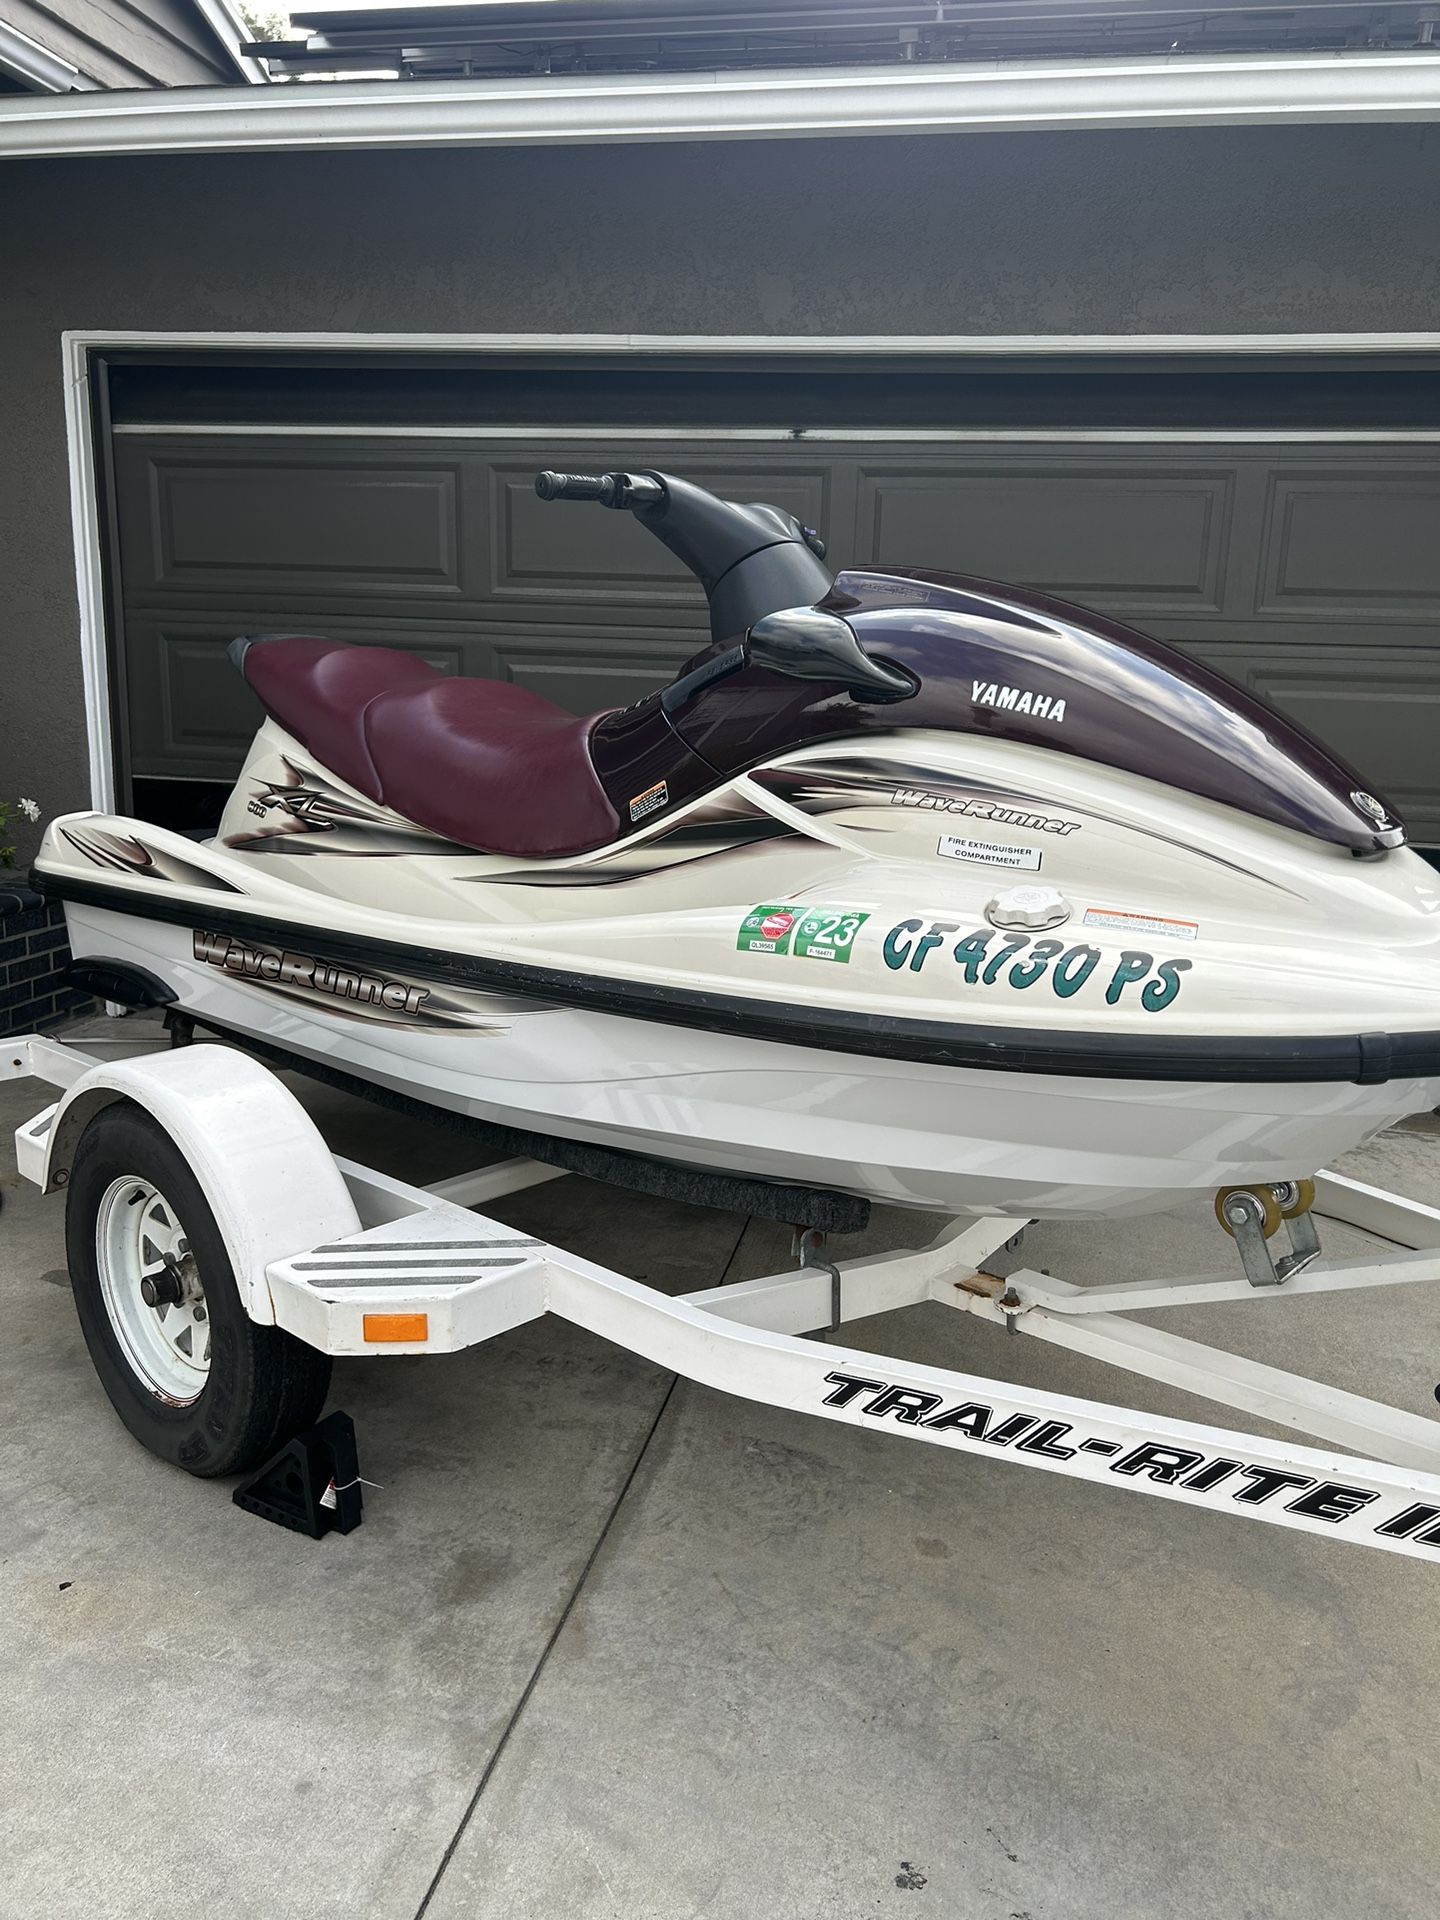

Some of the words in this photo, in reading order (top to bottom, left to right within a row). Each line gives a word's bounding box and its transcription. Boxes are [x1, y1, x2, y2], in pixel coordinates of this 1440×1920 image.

[971, 680, 1066, 722] YAMAHA
[890, 788, 1082, 836] WaveRunner
[947, 837, 967, 847] FIRE
[968, 841, 1032, 856] EXTINGUISHER
[954, 849, 1021, 866] COMPARTMENT
[813, 916, 861, 947] 23
[192, 929, 431, 1017] WaveRunner
[883, 919, 961, 972] CF
[954, 929, 1101, 999] 4730
[1105, 950, 1194, 1013] PS
[822, 1371, 1381, 1524] TRAIL-RITE
